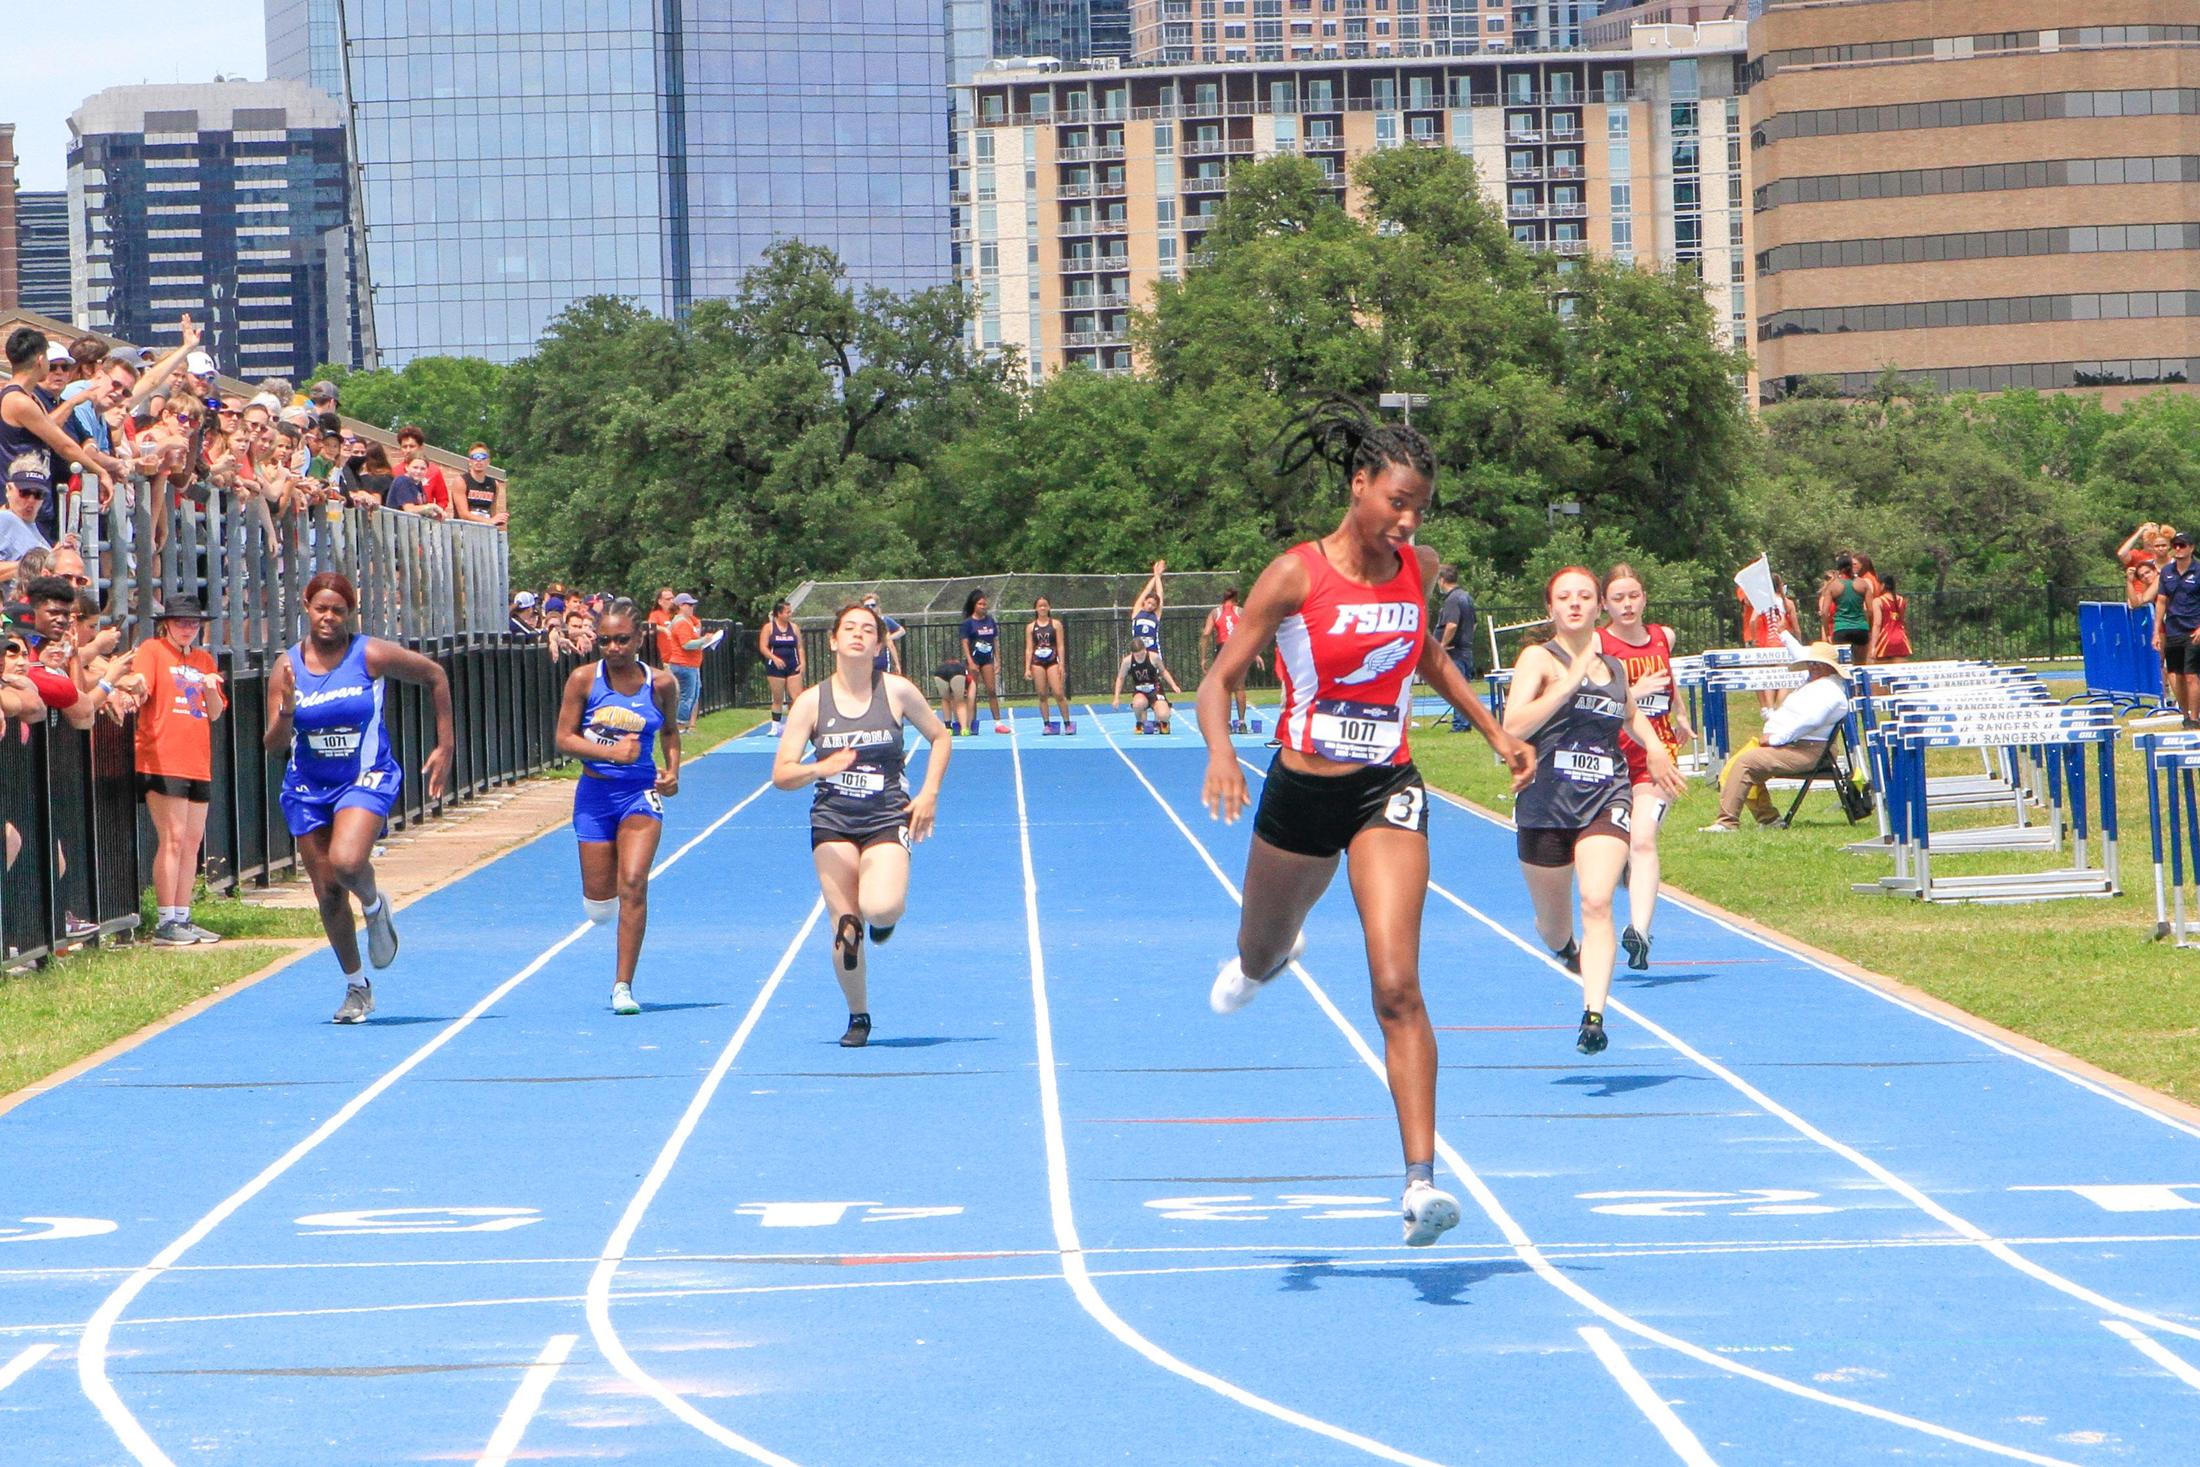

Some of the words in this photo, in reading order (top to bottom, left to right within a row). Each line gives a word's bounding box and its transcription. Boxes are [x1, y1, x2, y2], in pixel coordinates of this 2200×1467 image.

[1327, 602, 1420, 635] FSDB
[822, 730, 894, 748] ARIZONA
[1340, 720, 1377, 742] 1077
[1983, 732, 2047, 744] RANGERS
[323, 735, 348, 748] 1071
[1571, 754, 1601, 771] 1023
[841, 773, 868, 788] 1016
[1393, 790, 1415, 822] 3
